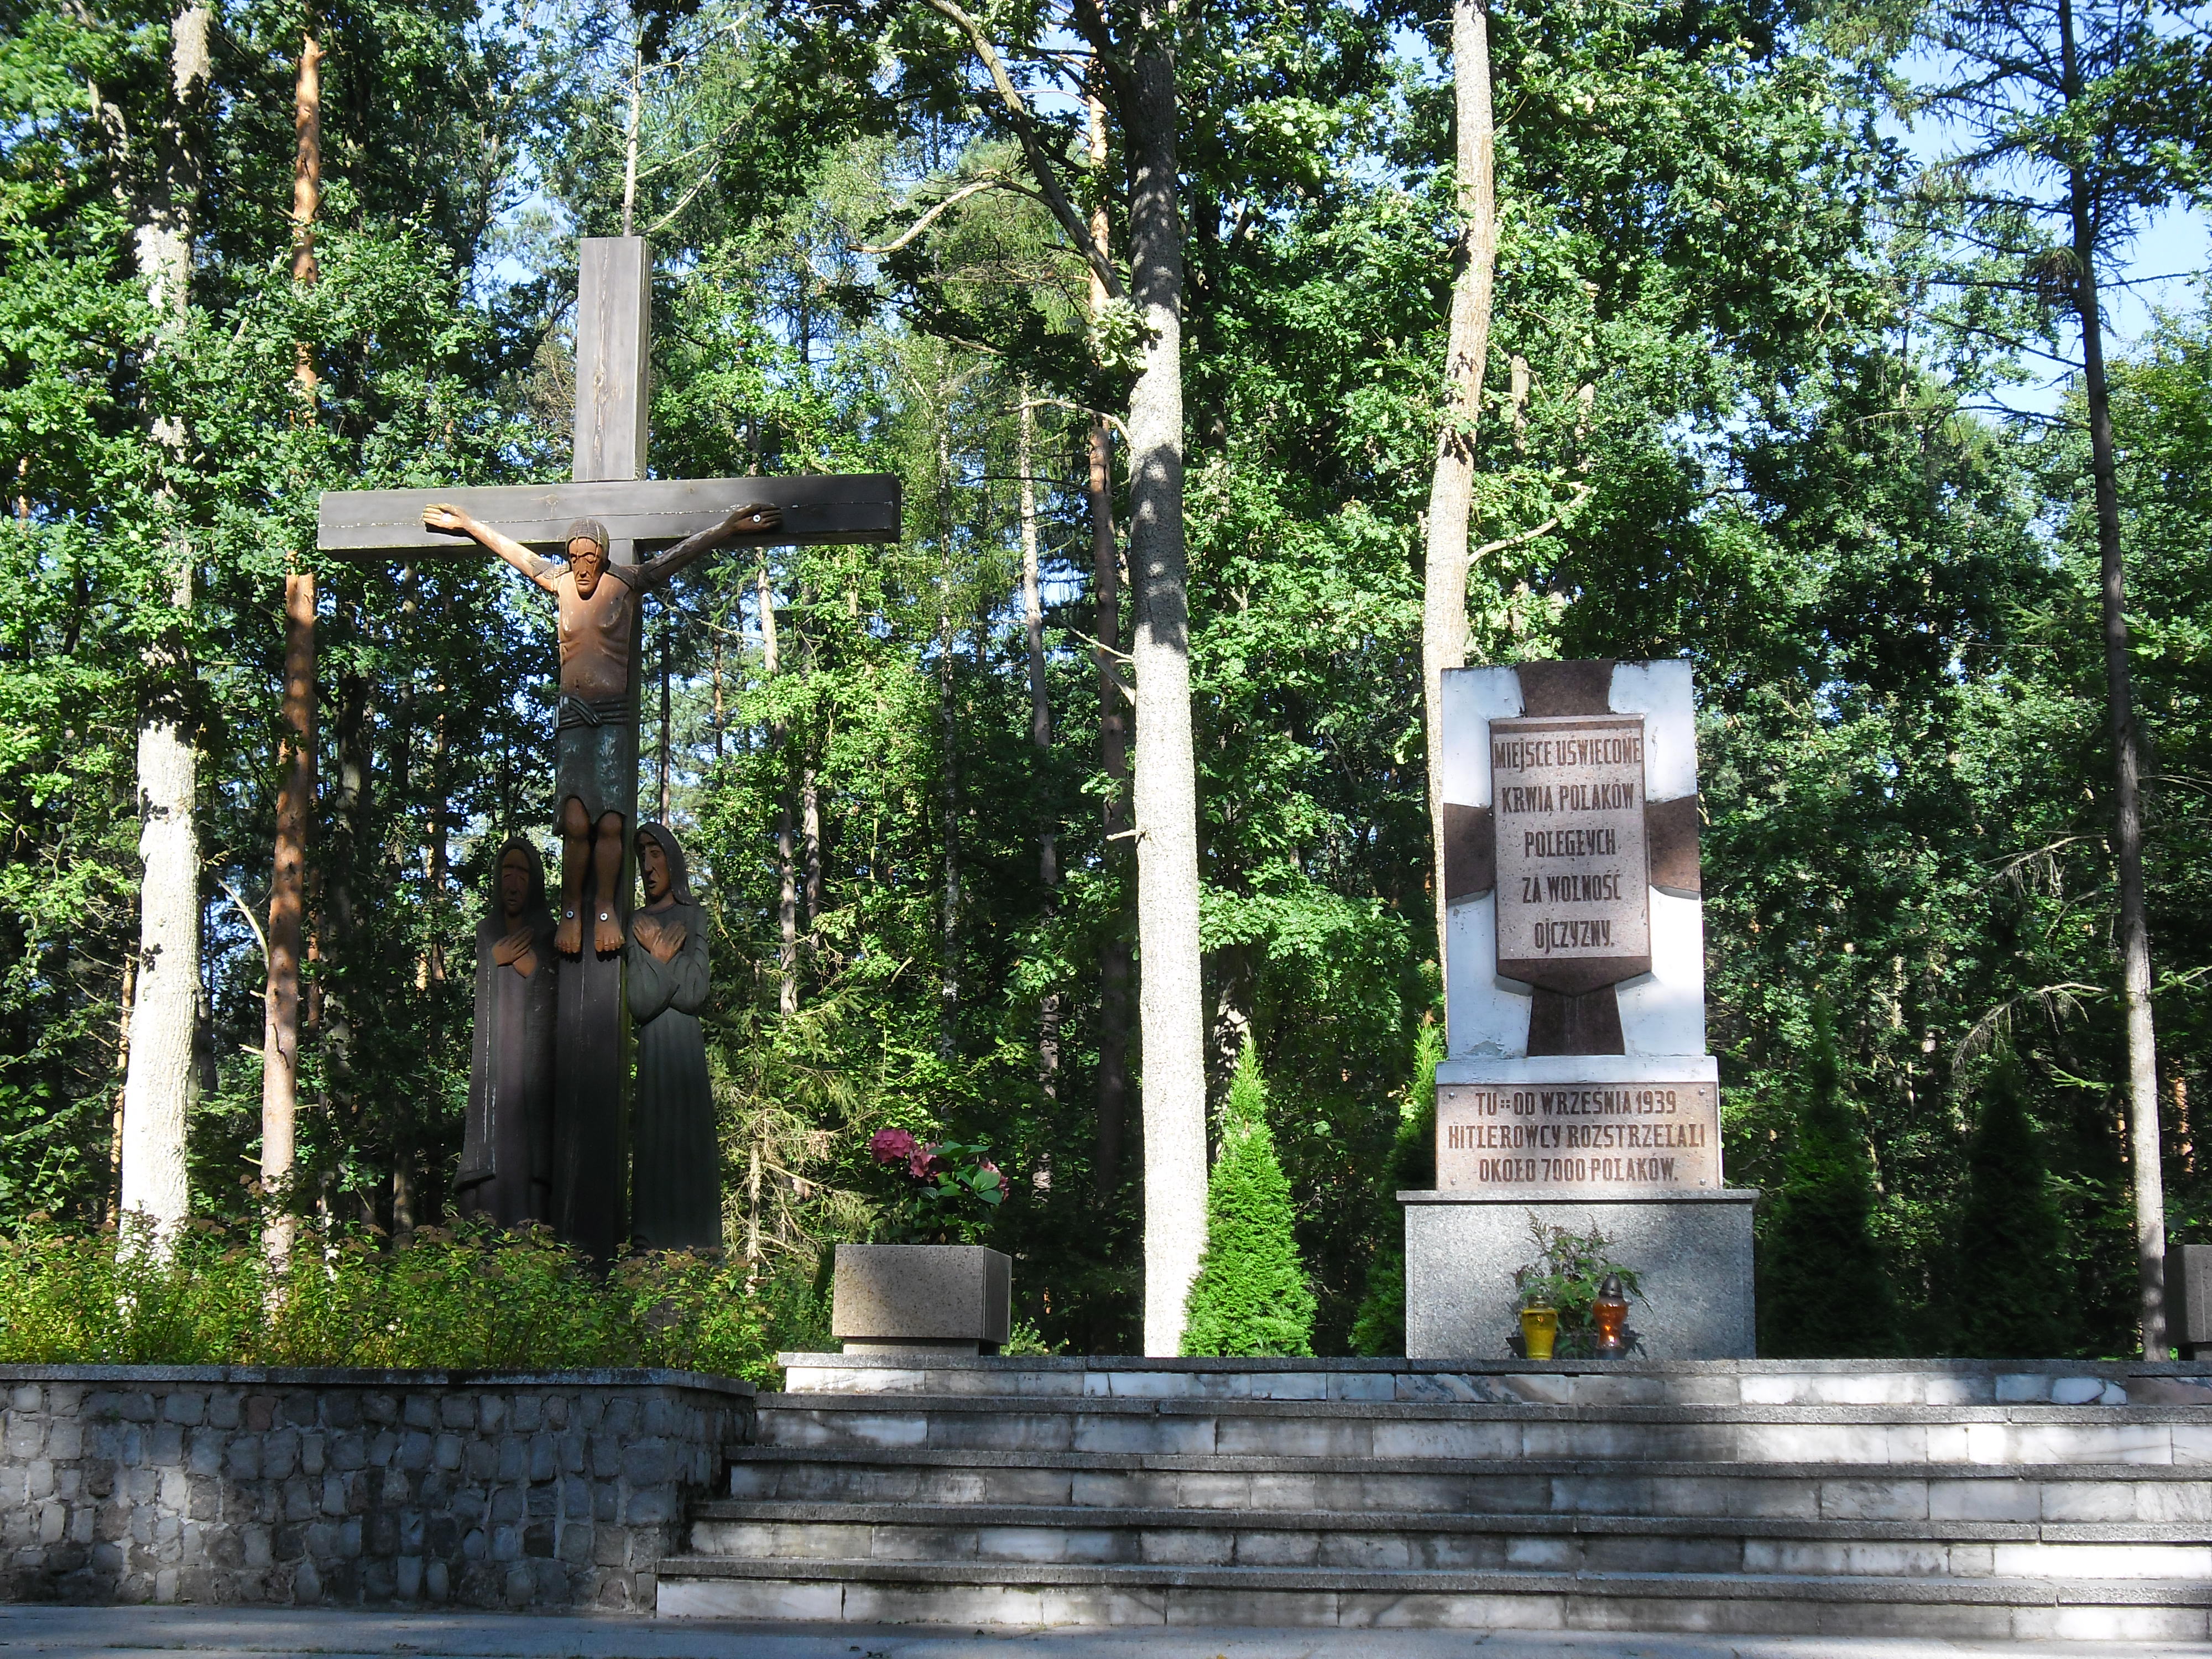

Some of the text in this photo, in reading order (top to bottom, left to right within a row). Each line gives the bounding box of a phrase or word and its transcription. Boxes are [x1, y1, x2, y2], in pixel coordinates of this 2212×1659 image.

[1559, 779, 1634, 812] POLAKÓW
[1525, 828, 1616, 858] POLEGŁYCH
[1522, 869, 1621, 903] ZA WOLNOŚĆ
[1475, 1087, 1677, 1116] TU OD WRZEŚNIA 1939
[1448, 1124, 1705, 1149] HITLEROWCY ROZSTRZELALI
[1479, 1153, 1679, 1182] OKOŁO 7000 POLAKÓW.
